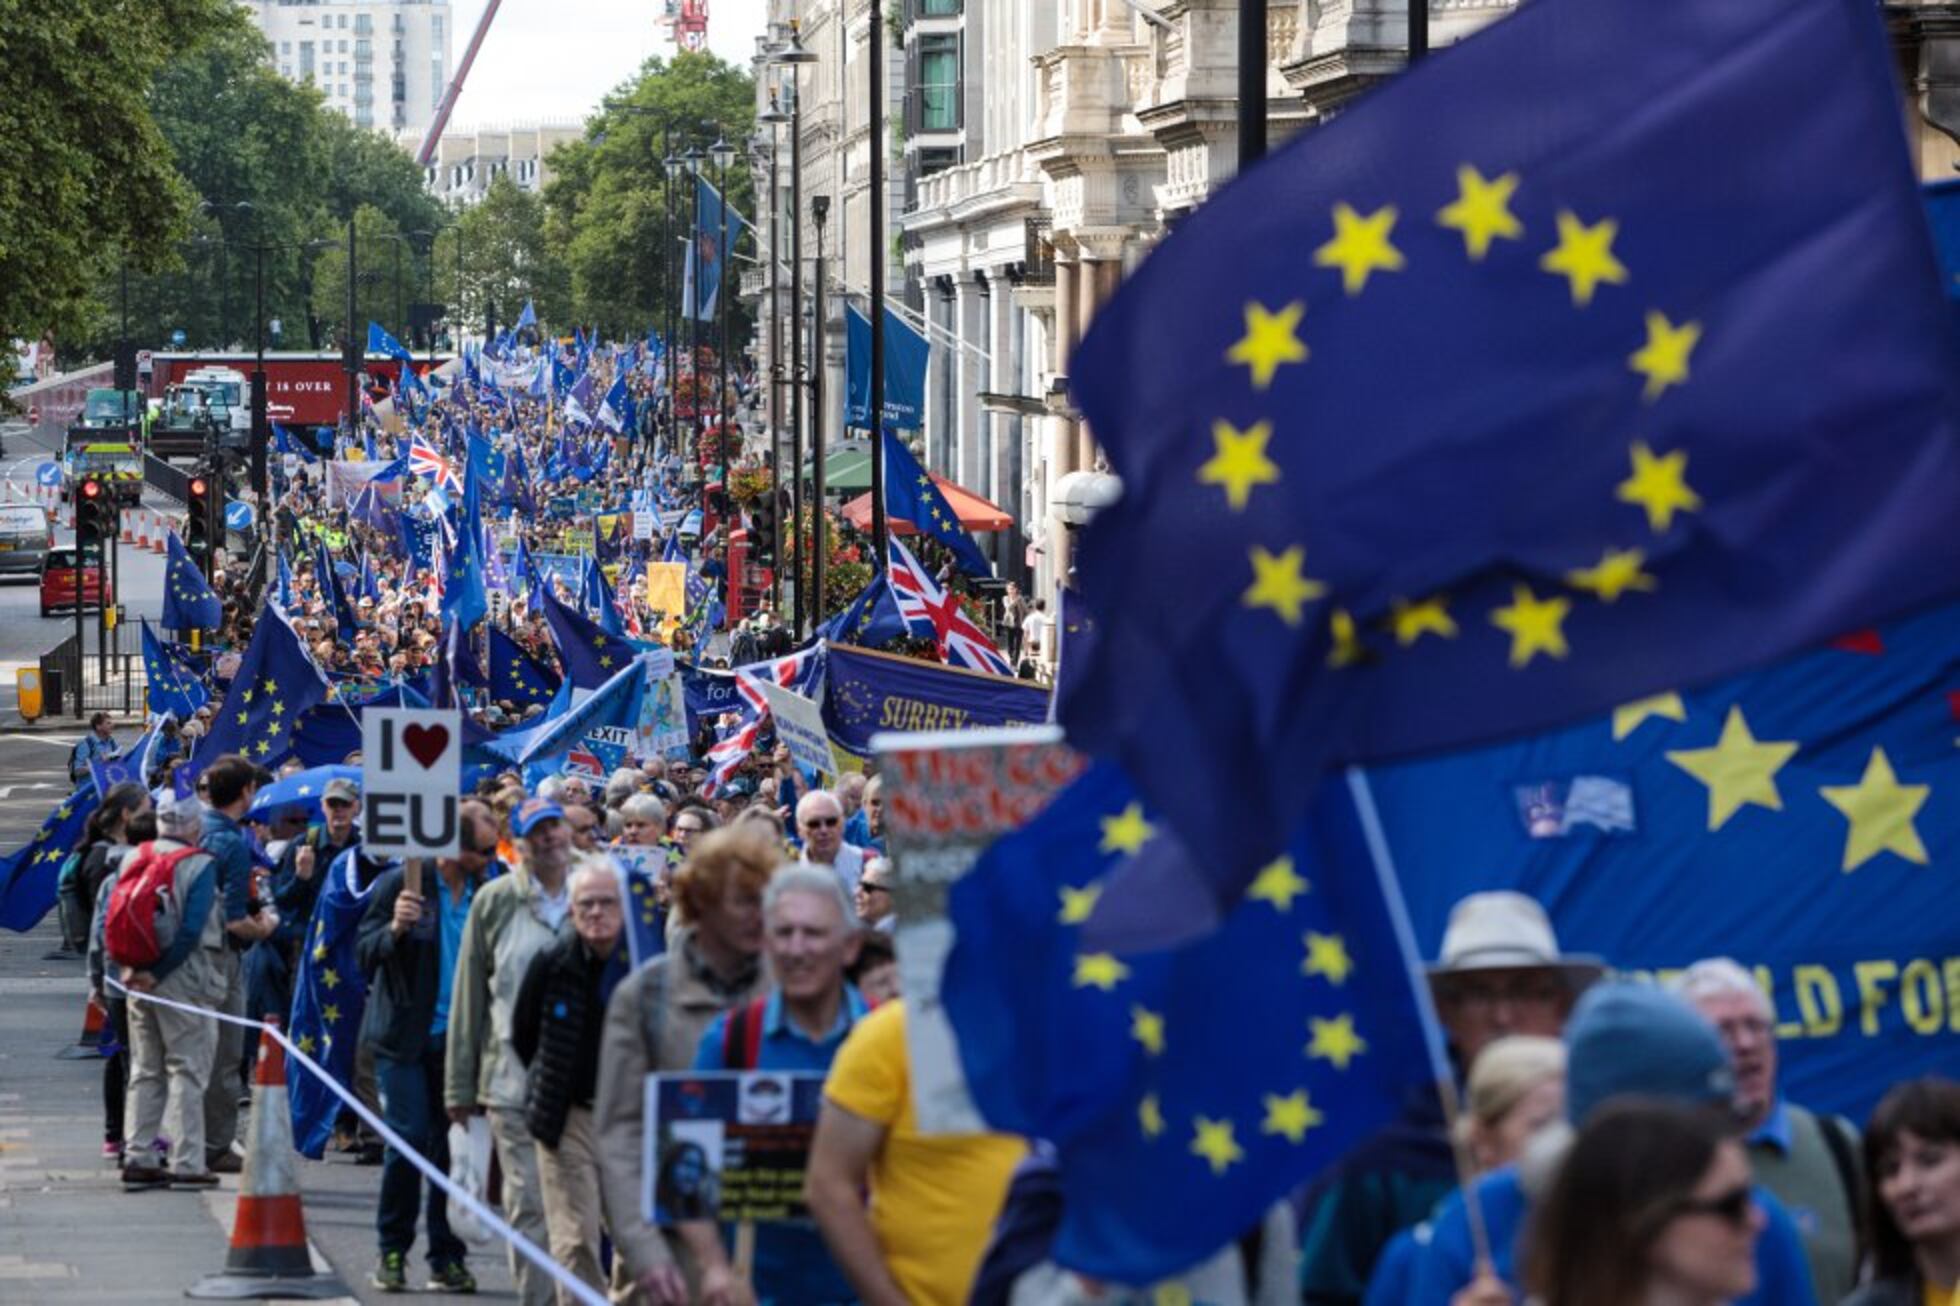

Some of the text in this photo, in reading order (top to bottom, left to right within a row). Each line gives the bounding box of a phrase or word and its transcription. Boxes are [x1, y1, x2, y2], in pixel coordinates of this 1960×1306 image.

[295, 382, 332, 392] OVER
[707, 681, 733, 700] for
[879, 695, 969, 732] SURREY
[381, 719, 393, 771] I
[366, 794, 456, 847] EU
